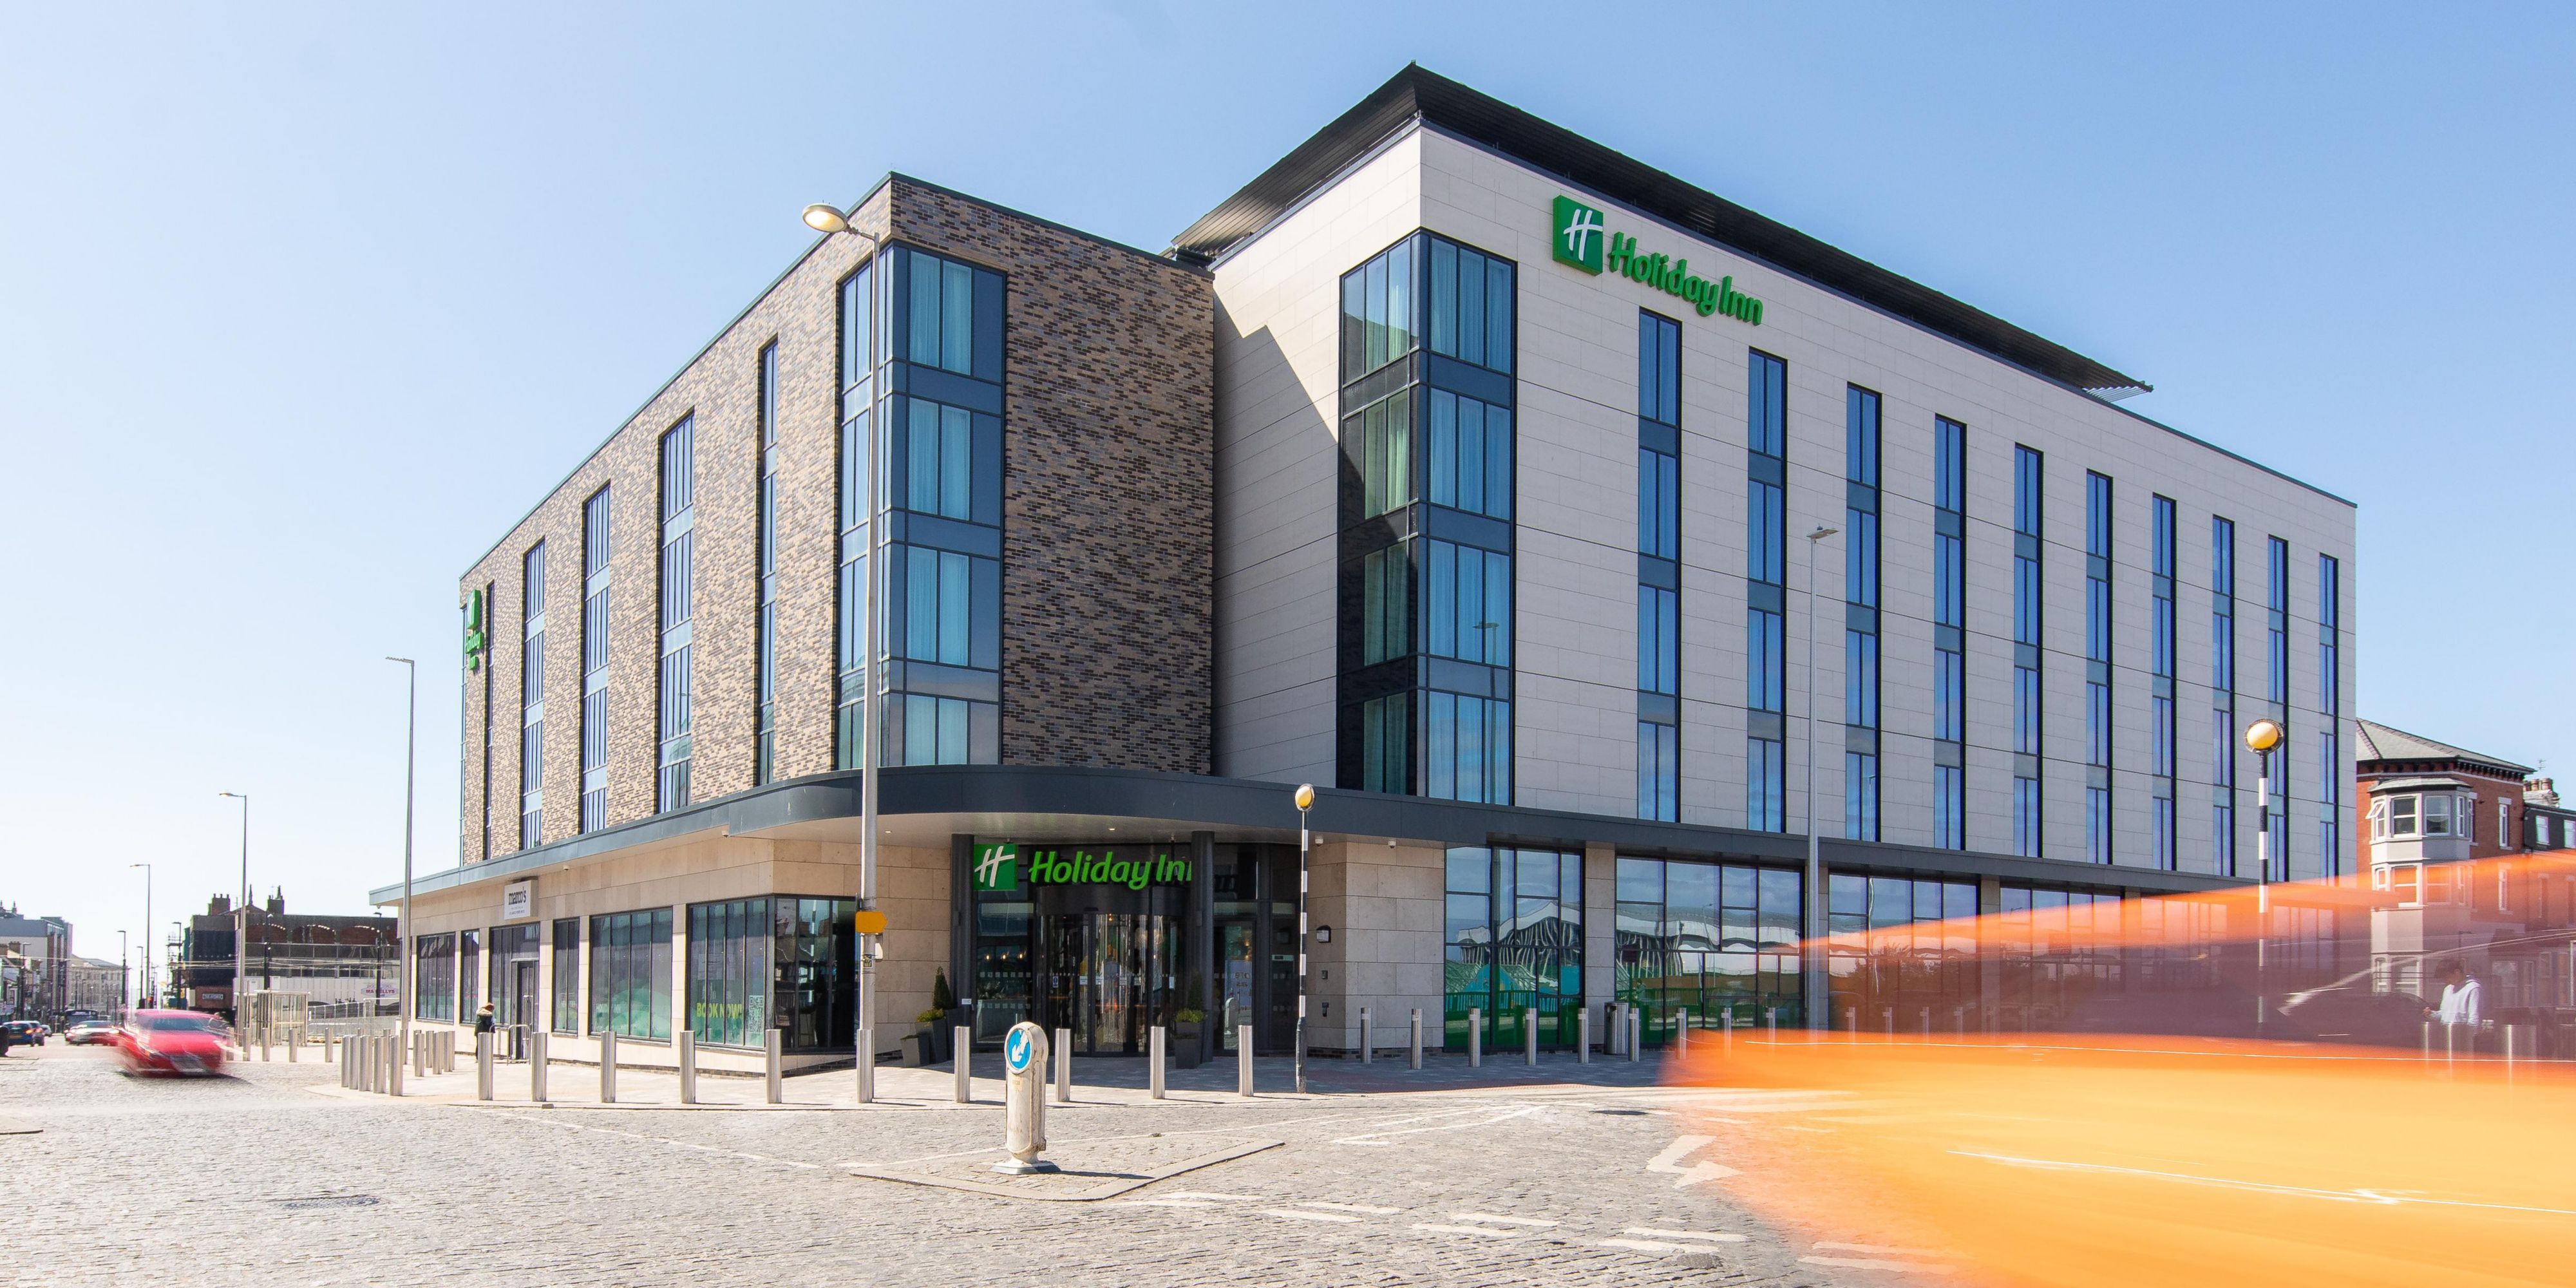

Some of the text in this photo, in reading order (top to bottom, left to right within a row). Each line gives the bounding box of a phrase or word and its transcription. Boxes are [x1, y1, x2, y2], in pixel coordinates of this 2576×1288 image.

[1607, 232, 1763, 326] Holiday Inn
[1028, 851, 1151, 890] Holiday
[509, 886, 526, 905] marco's
[696, 1003, 719, 1018] BOOK
